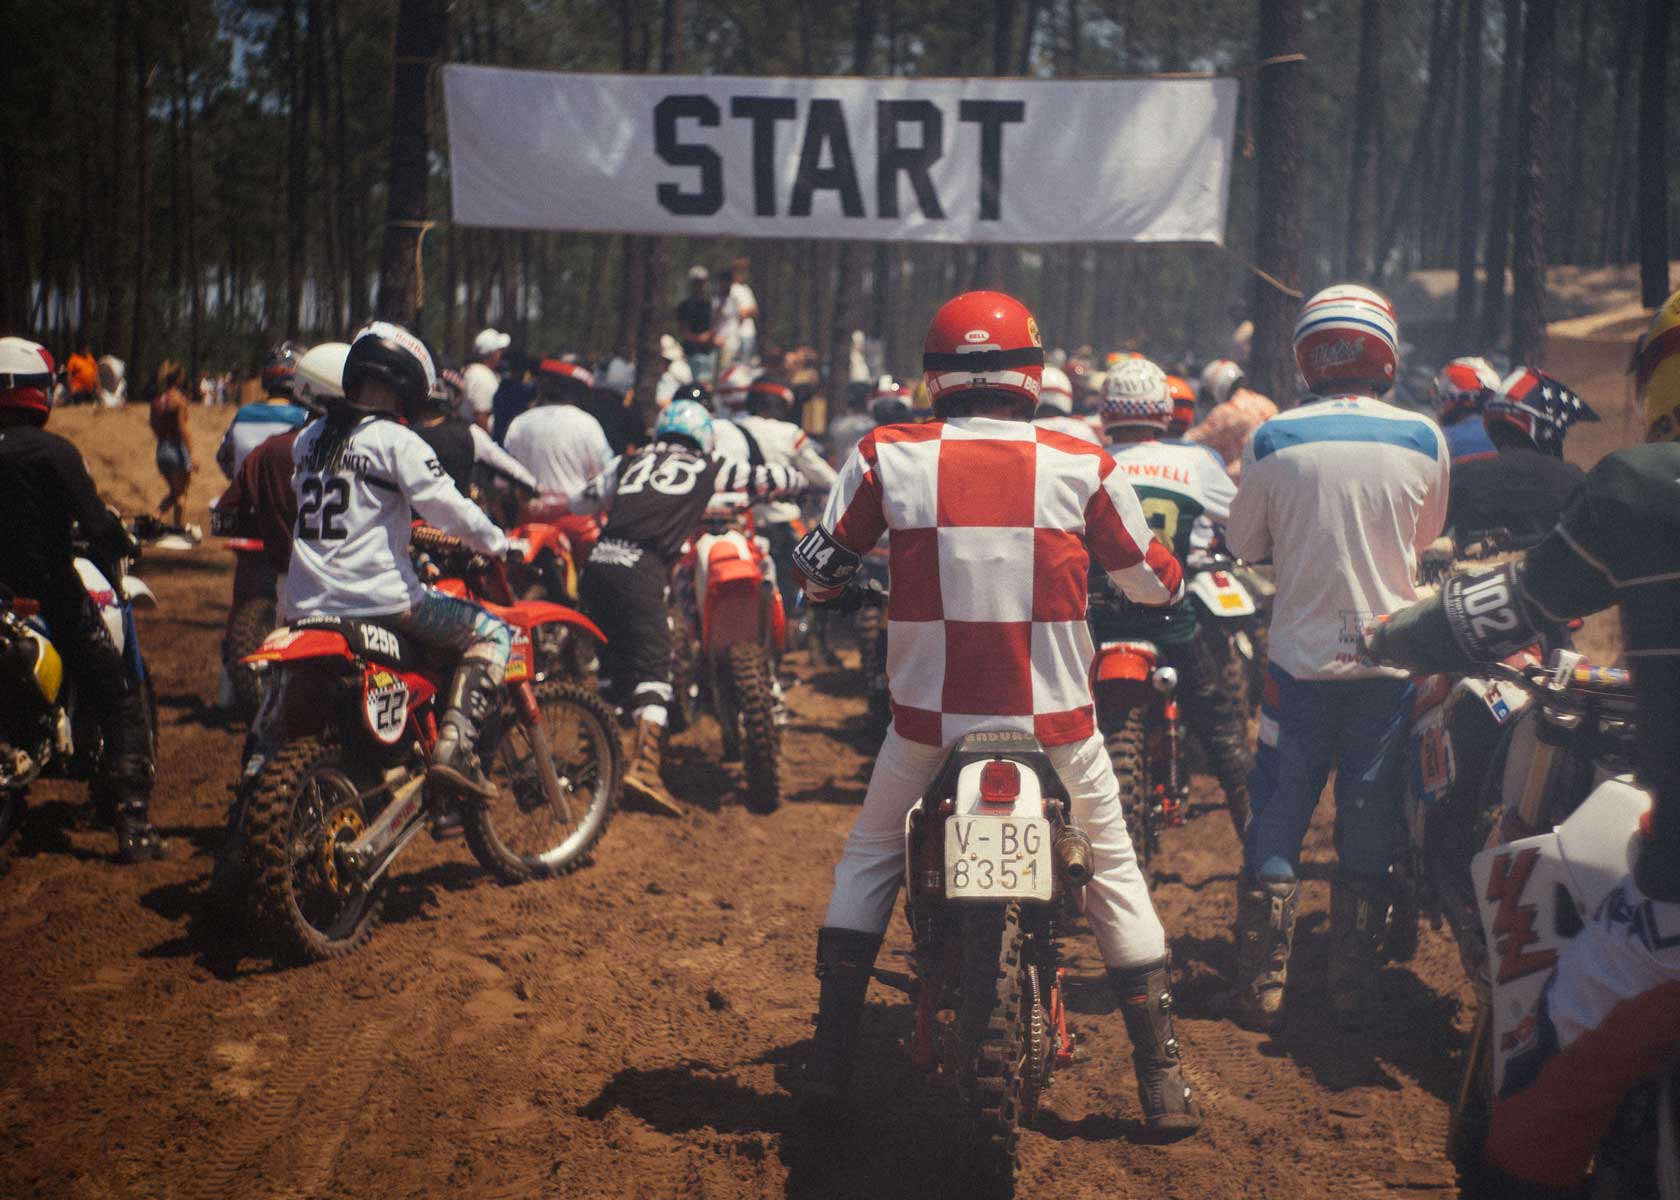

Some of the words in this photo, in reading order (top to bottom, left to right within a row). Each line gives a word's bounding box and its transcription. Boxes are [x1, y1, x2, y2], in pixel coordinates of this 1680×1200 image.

[654, 94, 1025, 220] START
[1121, 464, 1190, 485] NWELL
[298, 477, 350, 540] 22
[802, 530, 835, 569] 114
[1462, 573, 1518, 639] 102
[377, 690, 406, 730] 22
[954, 858, 1038, 890] 8351
